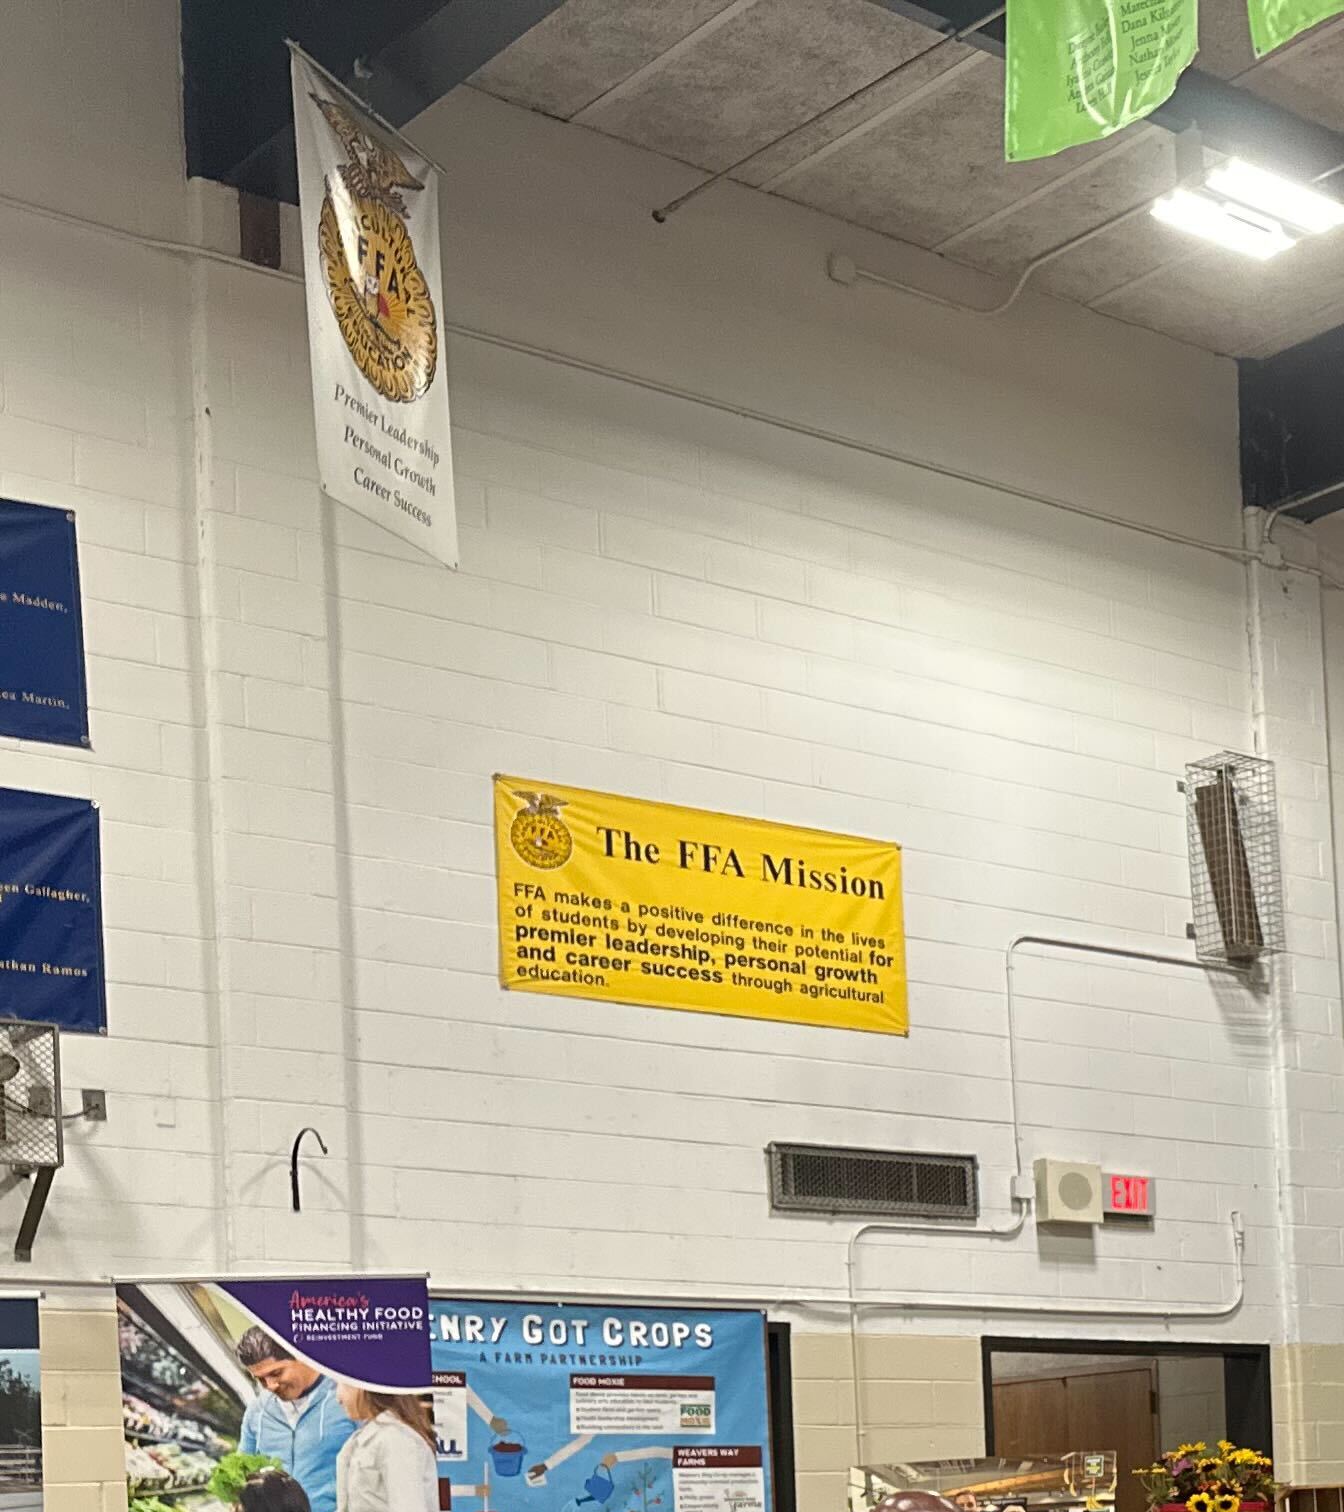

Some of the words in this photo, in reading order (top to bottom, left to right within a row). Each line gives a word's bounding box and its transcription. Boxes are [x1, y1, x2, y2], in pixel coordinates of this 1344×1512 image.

[358, 235, 400, 299] FFA
[335, 383, 378, 426] Premier
[381, 415, 440, 471] Leadership
[344, 424, 392, 470] Personal
[394, 457, 436, 497] Growth
[353, 466, 392, 502] Career
[394, 489, 432, 527] Success
[597, 825, 661, 864] The
[679, 839, 745, 878] FFA
[762, 852, 885, 901] Mission
[24, 883, 91, 904] Gallagher,
[513, 881, 546, 901] FFA
[554, 889, 612, 911] makes
[620, 900, 630, 913] a
[638, 902, 704, 925] positive
[712, 910, 794, 937] difference
[800, 923, 814, 939] in
[821, 925, 845, 944] the
[851, 930, 886, 950] lives
[514, 902, 534, 919] of
[541, 906, 619, 932] students
[627, 917, 647, 937] by
[655, 921, 745, 951] developing
[752, 934, 788, 954] their
[794, 940, 863, 965] potential
[869, 950, 895, 969] for
[515, 924, 597, 949] premier
[606, 934, 716, 967] leadership,
[724, 950, 807, 977] personal
[814, 963, 879, 986] growth
[42, 962, 88, 977] Ramos
[516, 944, 556, 963] and
[565, 952, 632, 973] career
[640, 963, 724, 985] success
[731, 971, 793, 995] through
[799, 980, 885, 1005] agricultural
[516, 965, 610, 989] education.
[1109, 1175, 1150, 1211] EXIT
[290, 1289, 370, 1309] America's
[291, 1307, 369, 1322] HEALTHY
[374, 1306, 424, 1321] FOOD
[291, 1321, 359, 1332] FINANCING
[362, 1320, 423, 1331] INITIATIVE
[479, 1351, 488, 1364] A
[495, 1351, 533, 1365] FARM
[541, 1352, 644, 1367] PARTNERSHIP
[572, 1377, 597, 1386] FOOD
[680, 1405, 712, 1417] FOOD
[677, 1448, 718, 1457] WEAVERS
[719, 1448, 739, 1457] WAY
[677, 1458, 706, 1466] FARMS
